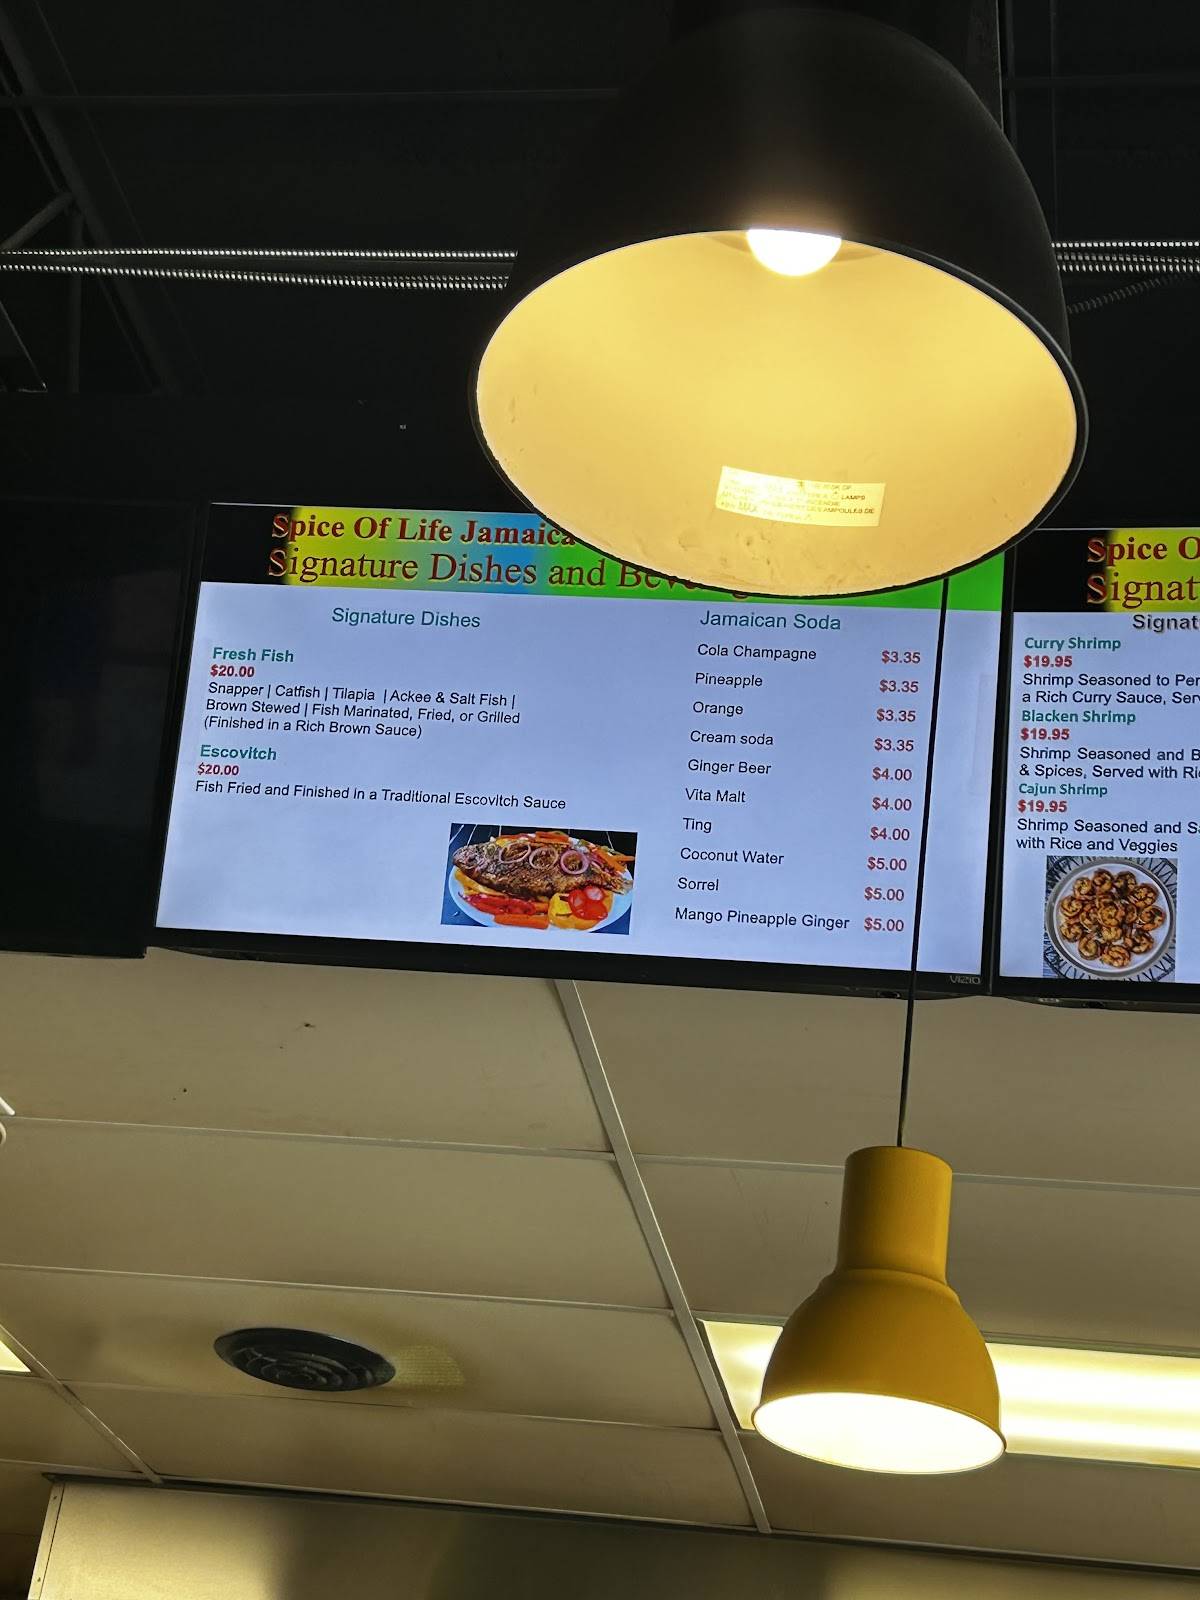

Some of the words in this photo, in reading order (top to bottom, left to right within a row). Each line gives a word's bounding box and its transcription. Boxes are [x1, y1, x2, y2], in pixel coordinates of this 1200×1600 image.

[272, 513, 345, 543] Spice
[354, 516, 392, 539] Of
[397, 517, 452, 543] Life
[1087, 537, 1167, 567] Spice
[268, 547, 419, 582] Signature
[430, 553, 537, 584] Dishes
[549, 559, 606, 585] and
[1087, 571, 1200, 609] Signat
[332, 608, 414, 626] Signature
[421, 611, 480, 627] Dishes
[700, 610, 786, 628] Jamaican
[794, 614, 840, 629] Soda
[1133, 615, 1200, 633] Signat
[1025, 638, 1064, 651] Curry
[1068, 637, 1121, 651] Shrimp
[213, 647, 256, 660] Fresh
[261, 649, 293, 662] Fish
[698, 644, 728, 656] Cola
[734, 645, 816, 661] Champagne
[882, 650, 920, 664] $3.35
[1024, 655, 1072, 668] $19.95
[210, 664, 254, 677] $20.00
[696, 673, 762, 688] Pineapple
[880, 679, 918, 693] $3.35
[1023, 673, 1073, 688] Shrimp
[1078, 674, 1151, 686] Seasoned
[1156, 675, 1169, 686] to
[209, 682, 264, 697] Snapper
[276, 685, 320, 698] Catfish
[333, 687, 374, 702] Tilapia
[390, 690, 431, 702] Ackee
[436, 692, 444, 703] &
[450, 693, 475, 704] Salt
[480, 694, 506, 706] Fish
[1022, 694, 1030, 702] a
[1036, 691, 1067, 702] Rich
[1073, 691, 1112, 706] Curry
[1116, 691, 1165, 705] Sauce,
[207, 699, 247, 711] Brown
[252, 701, 300, 713] Stewed
[313, 704, 339, 715] Fish
[344, 705, 412, 721] Marinated,
[418, 708, 454, 722] Fried,
[460, 713, 474, 721] or
[478, 711, 520, 723] Grilled
[693, 702, 743, 717] Orange
[877, 709, 915, 722] $3.35
[1022, 710, 1078, 722] Blacken
[1083, 710, 1136, 725] Shrimp
[205, 716, 264, 729] (Finished
[268, 719, 279, 730] in
[284, 722, 291, 730] a
[296, 720, 324, 732] Rich
[330, 722, 370, 734] Brown
[375, 724, 421, 739] Sauce)
[1021, 728, 1069, 740] $19.95
[691, 730, 735, 743] Cream
[740, 734, 773, 745] soda
[875, 738, 914, 752] $3.35
[201, 745, 276, 760] Escovitch
[1020, 747, 1070, 762] Shrimp
[1078, 747, 1150, 760] Seasoned
[1157, 749, 1184, 760] and
[198, 762, 239, 775] $20.00
[688, 759, 734, 774] Ginger
[739, 762, 771, 774] Beer
[873, 767, 912, 781] $4.00
[1020, 764, 1029, 775] &
[1035, 764, 1086, 779] Spices,
[1092, 765, 1143, 777] Served
[1148, 766, 1177, 778] with
[196, 780, 222, 792] Fish
[227, 782, 261, 794] Fried
[265, 784, 289, 795] and
[294, 785, 349, 798] Finished
[354, 788, 364, 799] in
[370, 792, 377, 800] a
[382, 789, 450, 803] Traditional
[455, 793, 518, 807] Escovitch
[524, 796, 565, 809] Sauce
[686, 788, 711, 800] Vita
[716, 790, 745, 802] Malt
[1019, 783, 1056, 796] Cajun
[1060, 783, 1107, 798] Shrimp
[872, 797, 912, 811] $4.00
[1018, 799, 1067, 813] $19.95
[683, 818, 711, 833] Ting
[1018, 818, 1068, 834] Shrimp
[1074, 819, 1147, 832] Seasoned
[1154, 822, 1181, 833] and
[870, 827, 909, 840] $4.00
[1016, 837, 1045, 848] with
[1051, 837, 1082, 849] Rice
[1087, 839, 1114, 850] and
[1119, 839, 1177, 854] Veggies
[681, 848, 737, 862] Coconut
[743, 850, 784, 864] Water
[867, 857, 907, 871] $5.00
[678, 877, 718, 890] Sorrel
[865, 887, 904, 901] $5.00
[676, 907, 722, 923] Mango
[728, 910, 796, 927] Pineapple
[802, 915, 850, 930] Ginger
[864, 917, 904, 931] $5.00
